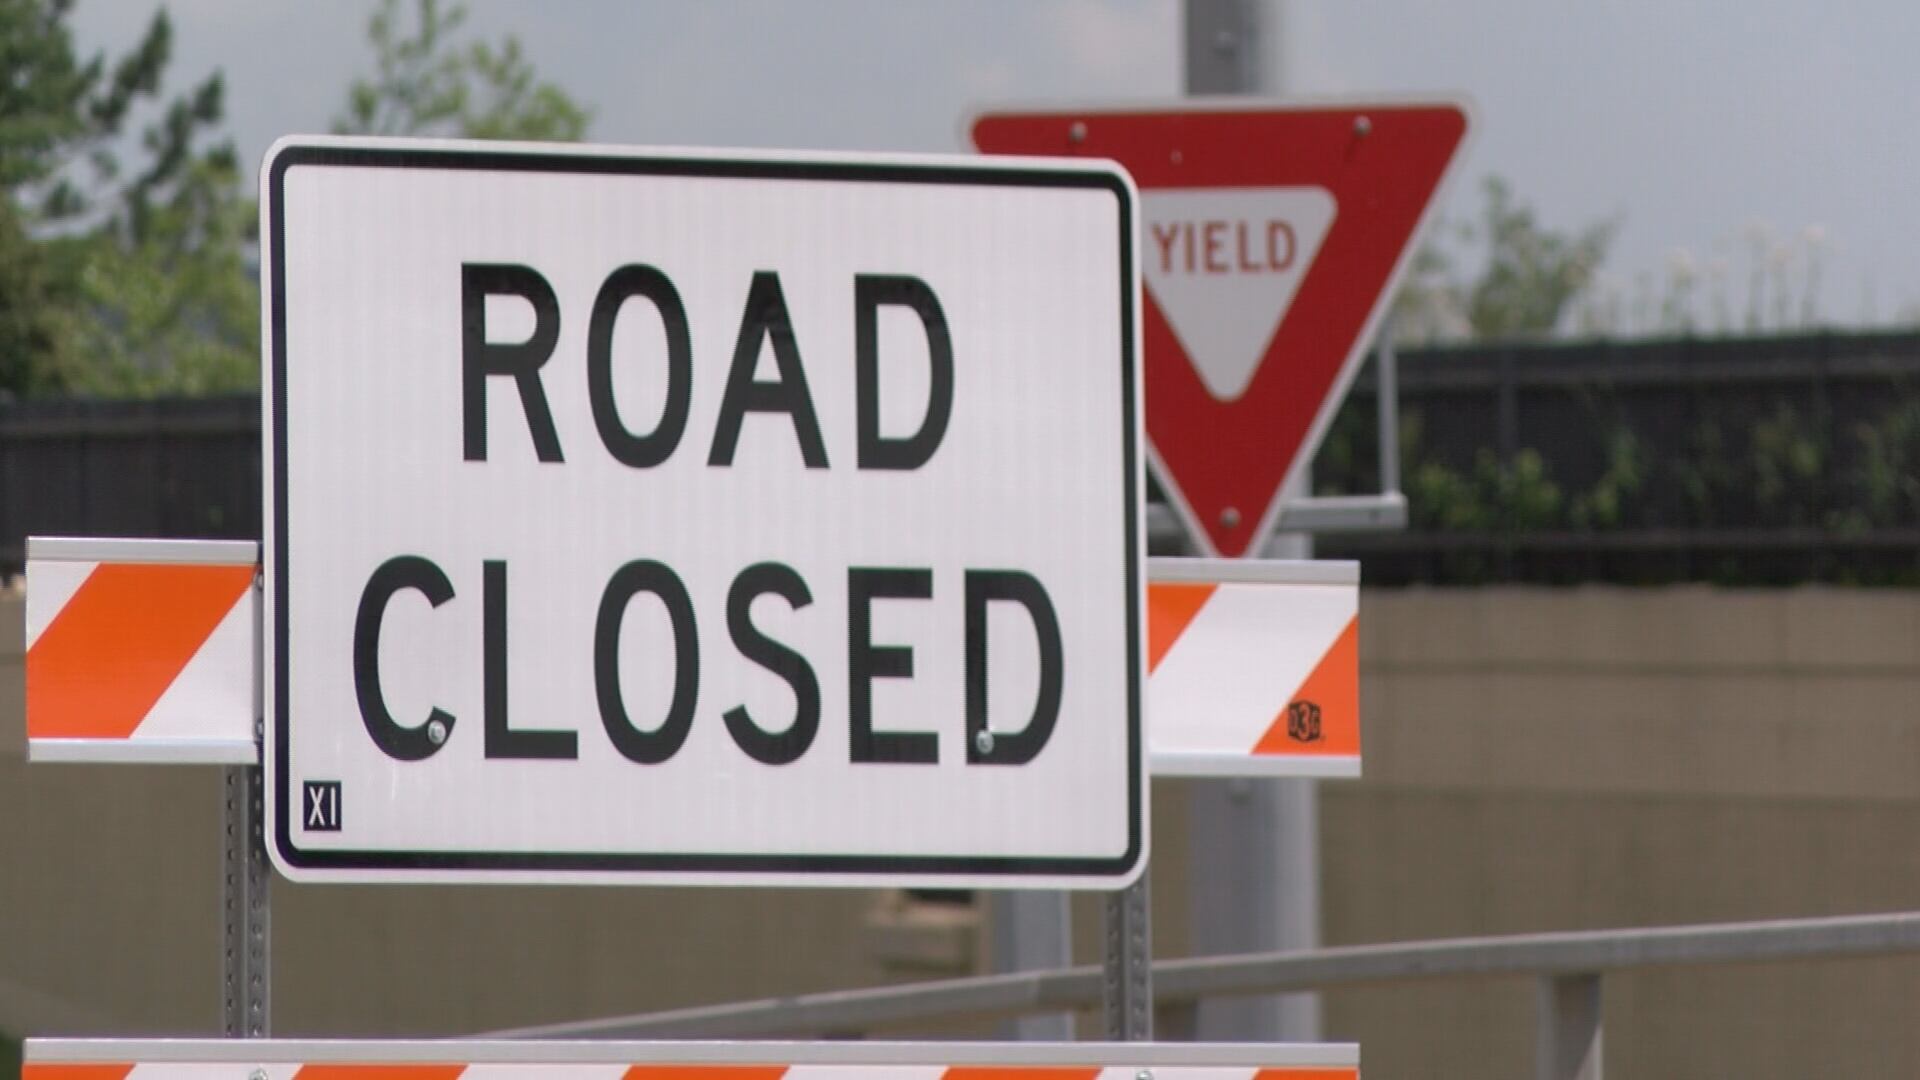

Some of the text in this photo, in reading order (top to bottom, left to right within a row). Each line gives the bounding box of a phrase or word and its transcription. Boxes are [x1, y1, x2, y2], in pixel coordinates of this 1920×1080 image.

[1152, 219, 1296, 275] YIELD
[460, 262, 955, 471] ROAD
[352, 555, 1064, 766] CLOSED
[308, 785, 336, 826] XI
